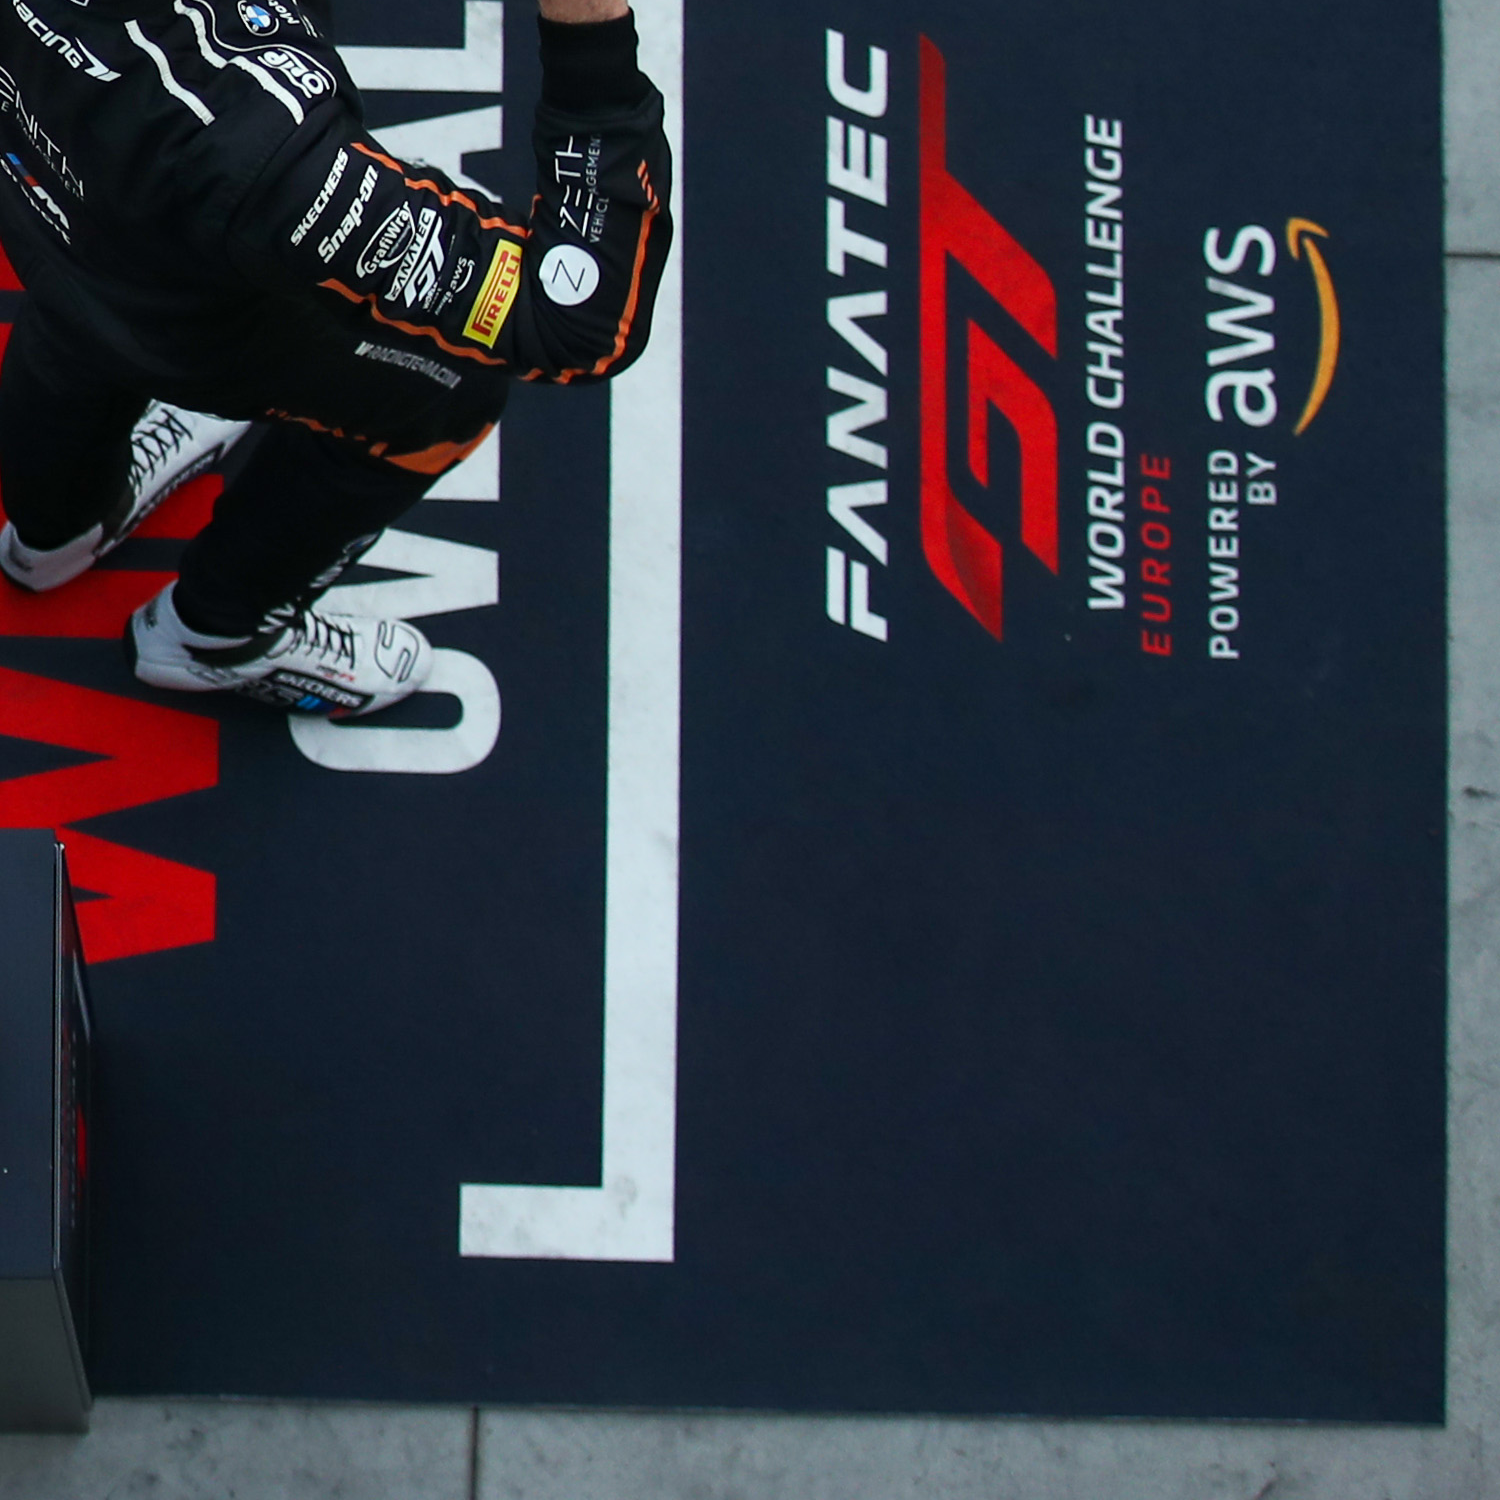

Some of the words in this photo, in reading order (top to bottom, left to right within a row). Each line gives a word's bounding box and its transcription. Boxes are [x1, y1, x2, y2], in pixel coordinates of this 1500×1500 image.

[290, 148, 350, 246] SKECHERS
[317, 165, 380, 264] Snap-on
[405, 217, 441, 308] GT
[451, 256, 468, 290] aws
[1085, 113, 1124, 410] CHALLENGE
[471, 253, 518, 342] PIRELLI
[826, 29, 889, 643] FANATEC
[920, 32, 1059, 643] GT
[1203, 223, 1278, 427] aws
[1087, 421, 1126, 610] WORLD
[1141, 453, 1172, 657] EUROPE
[1209, 448, 1239, 659] POWERED
[1247, 453, 1277, 505] BY
